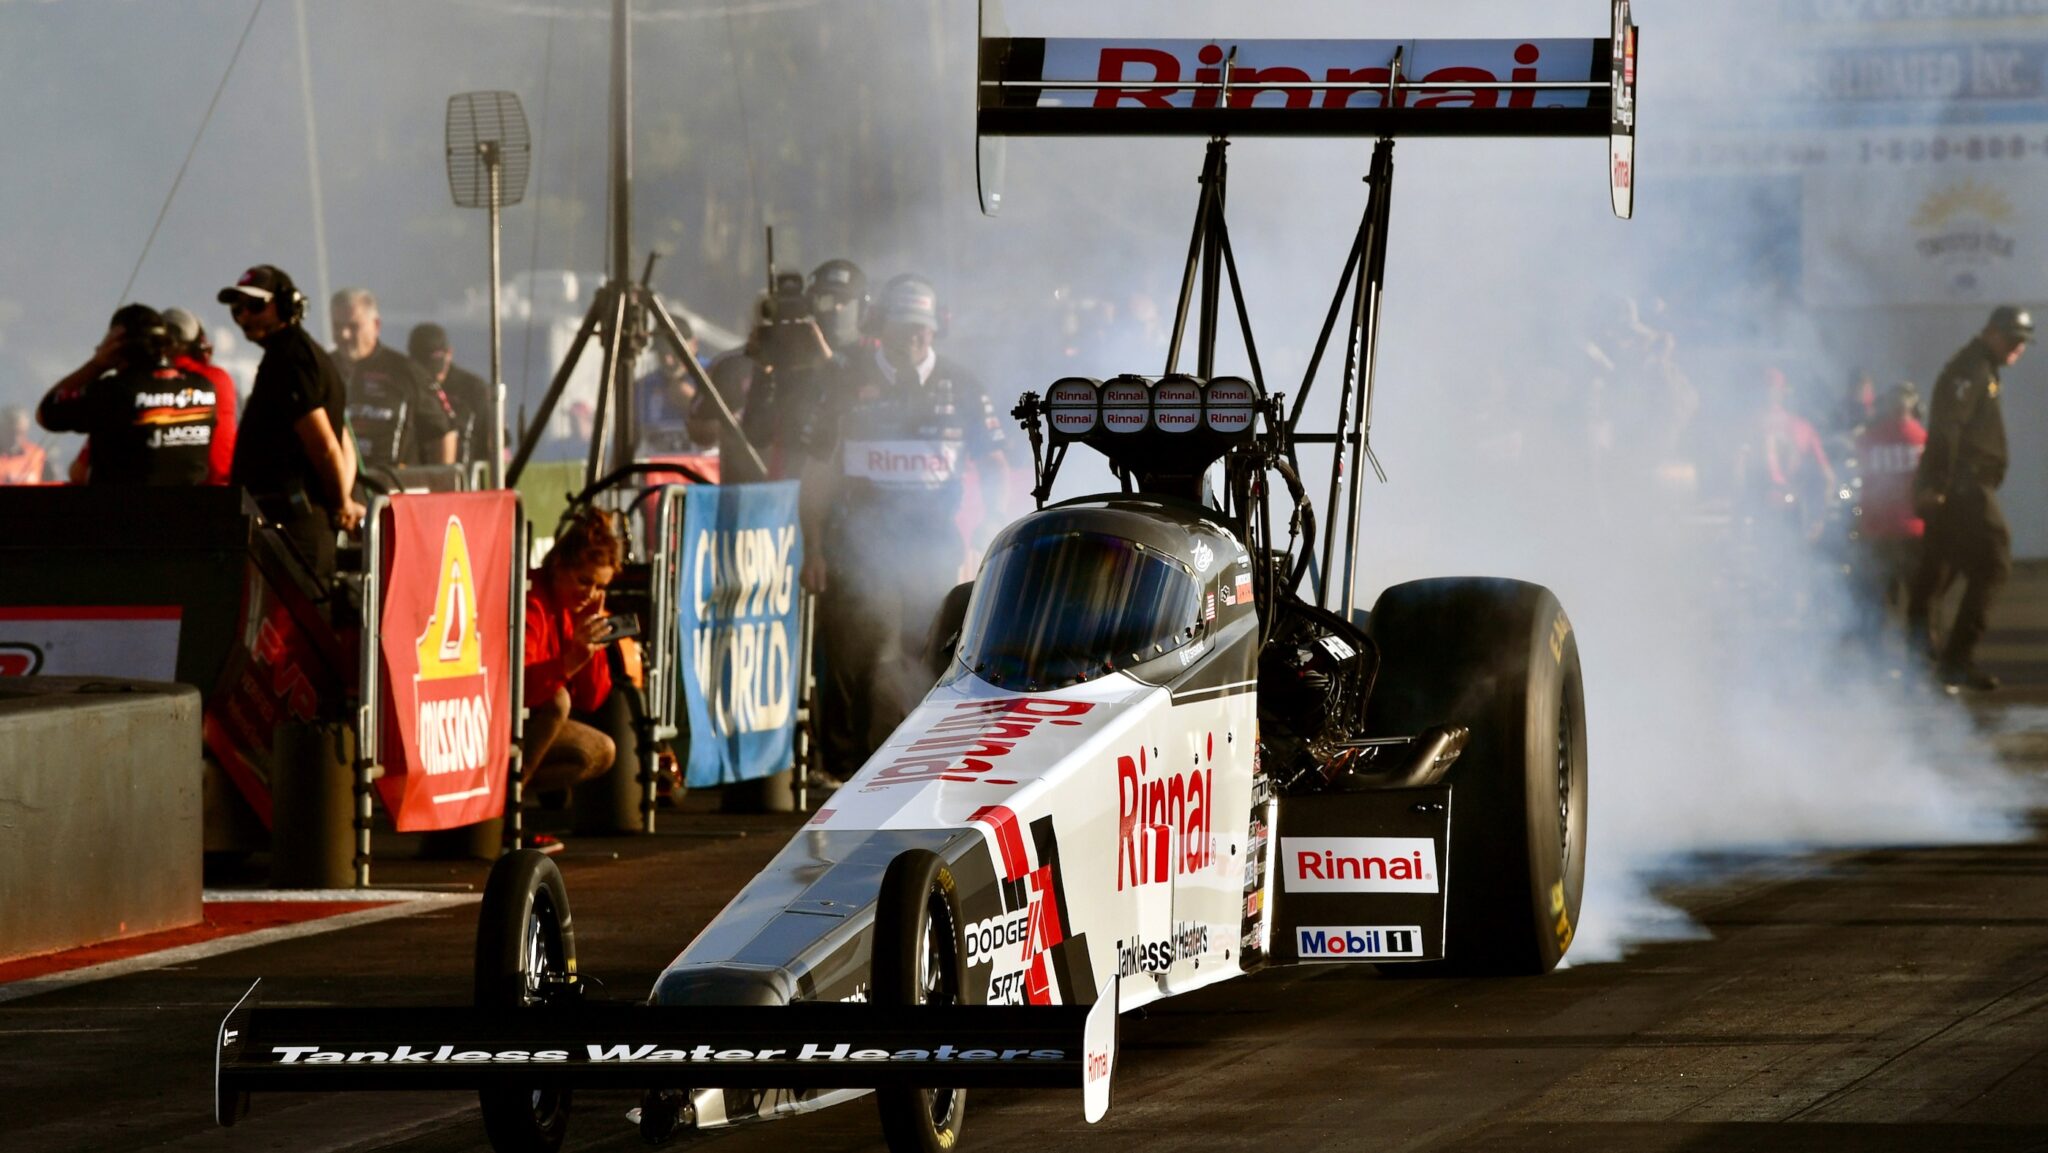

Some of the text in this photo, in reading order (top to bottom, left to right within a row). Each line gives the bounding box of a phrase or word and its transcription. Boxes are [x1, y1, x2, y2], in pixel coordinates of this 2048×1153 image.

[1093, 43, 1537, 108] Rinnai
[1055, 391, 1092, 400] Rinnai
[1107, 391, 1144, 400] Rinnai
[1159, 390, 1196, 400] Rinnai
[1211, 389, 1248, 399] Rinnai
[1055, 414, 1092, 424] Rinnai
[1107, 414, 1144, 424] Rinnai
[1158, 414, 1195, 424] Rinnai
[1210, 413, 1247, 423] Rinnai
[867, 450, 949, 472] Rinnai
[694, 525, 795, 622] CAMPING
[693, 620, 790, 737] WORLD
[419, 694, 489, 775] MISSION
[865, 697, 1096, 788] Rinnai
[1117, 731, 1213, 892] Rinnai
[1297, 850, 1423, 880] Rinnai
[966, 917, 1029, 958] DODGE
[1301, 931, 1380, 953] Mobil
[1117, 934, 1171, 978] Tankless
[989, 969, 1024, 1004] SRT
[271, 1043, 1066, 1063] Tankless Water Heaters
[1088, 1044, 1108, 1084] Rinnai
